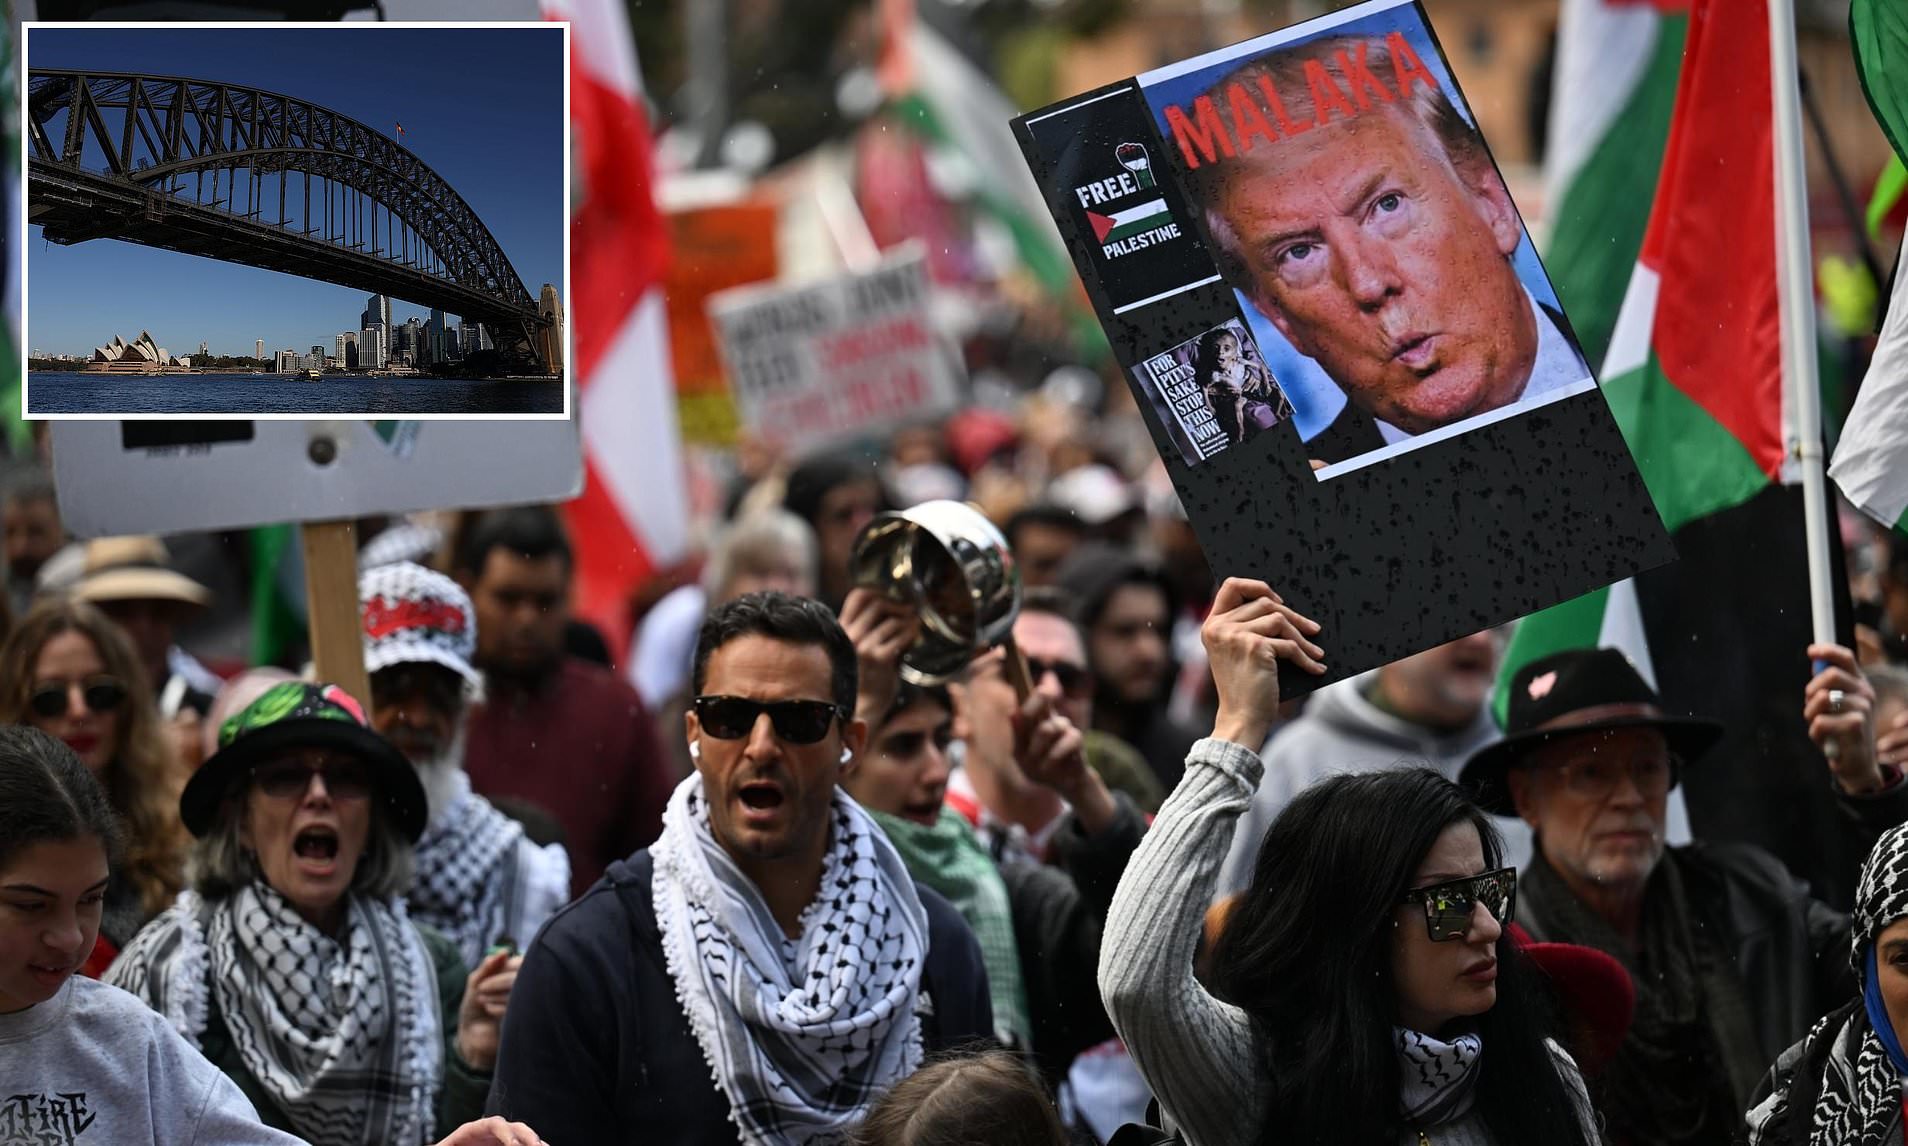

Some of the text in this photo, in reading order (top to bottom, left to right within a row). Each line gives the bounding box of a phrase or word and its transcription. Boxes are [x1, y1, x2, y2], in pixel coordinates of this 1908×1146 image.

[1163, 31, 1437, 170] MALAKA
[1074, 172, 1137, 209] FREE
[1102, 223, 1182, 260] PALESTINE
[1150, 353, 1178, 375] FOR
[1158, 361, 1197, 389] PITY'S
[1167, 377, 1201, 402] SAKE
[1175, 392, 1205, 416] STOP
[1183, 405, 1213, 427] THIS
[1194, 418, 1221, 442] NOW
